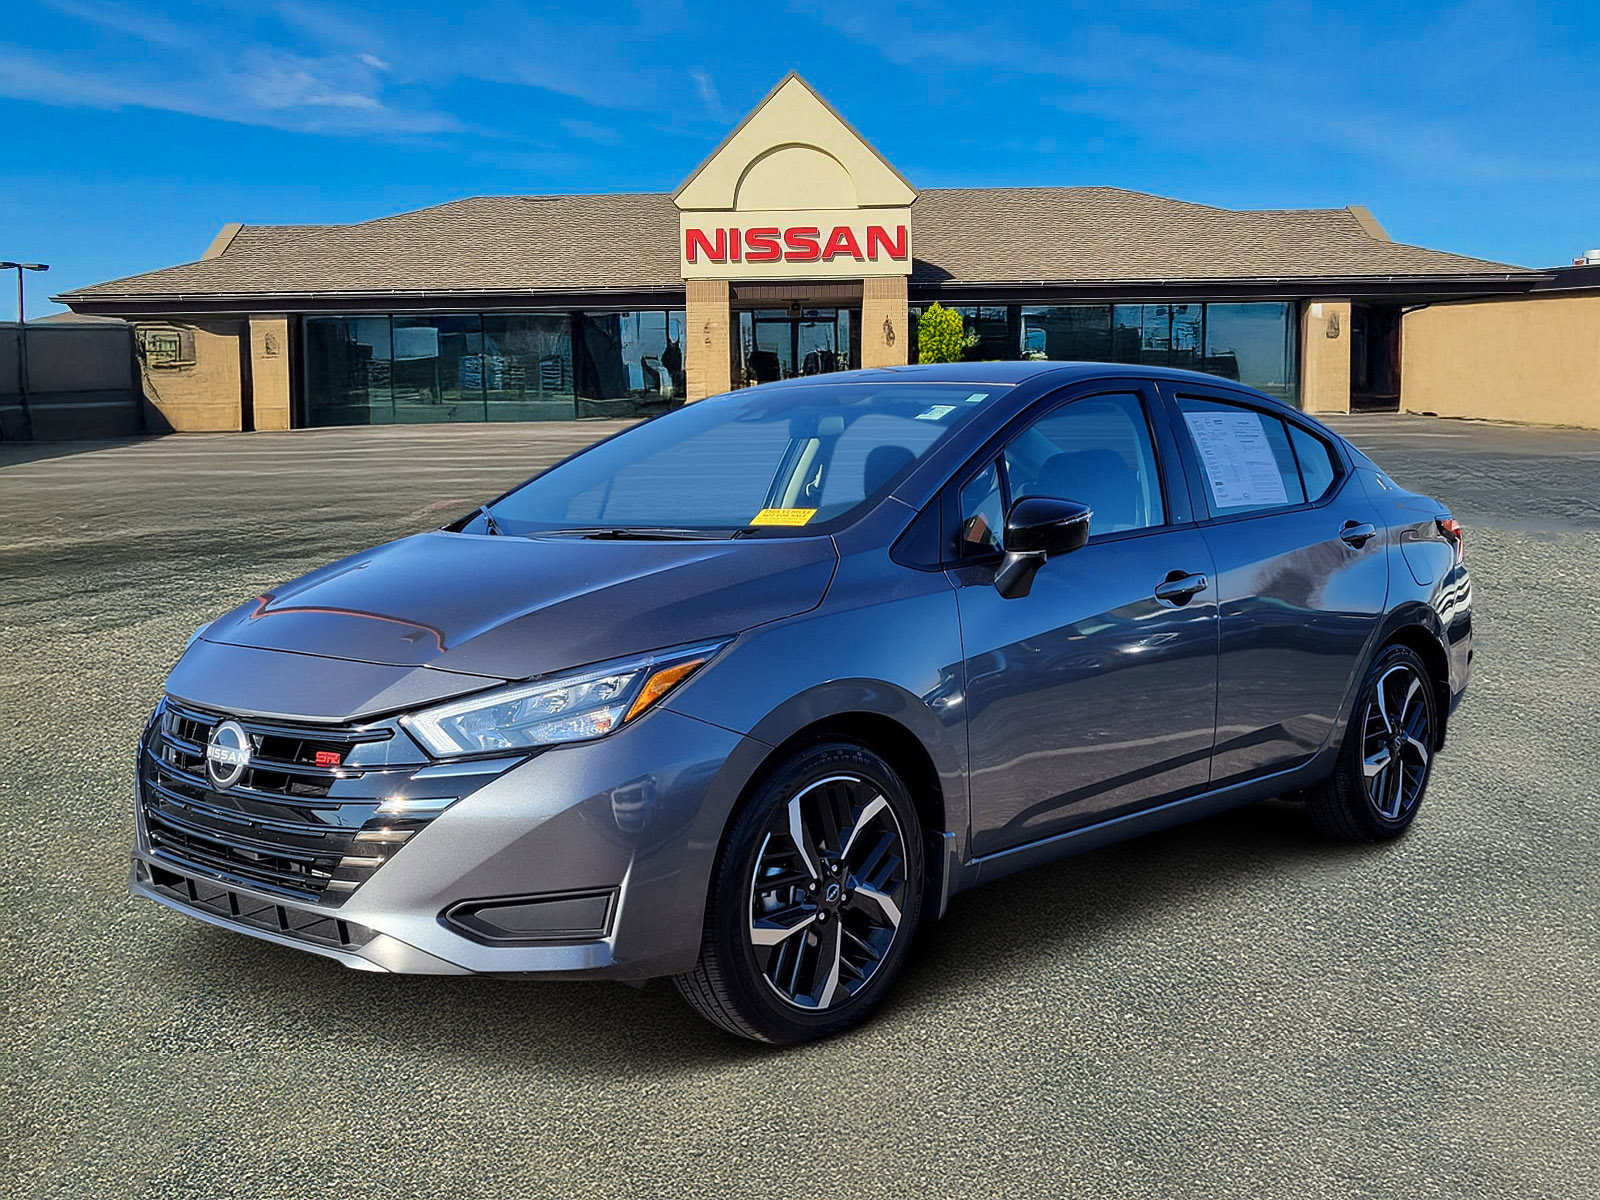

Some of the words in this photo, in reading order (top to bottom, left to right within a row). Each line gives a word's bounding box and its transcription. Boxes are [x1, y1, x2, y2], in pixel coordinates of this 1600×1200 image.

[686, 226, 907, 263] NISSAN
[207, 746, 250, 765] NISSAN
[315, 751, 341, 765] SR
